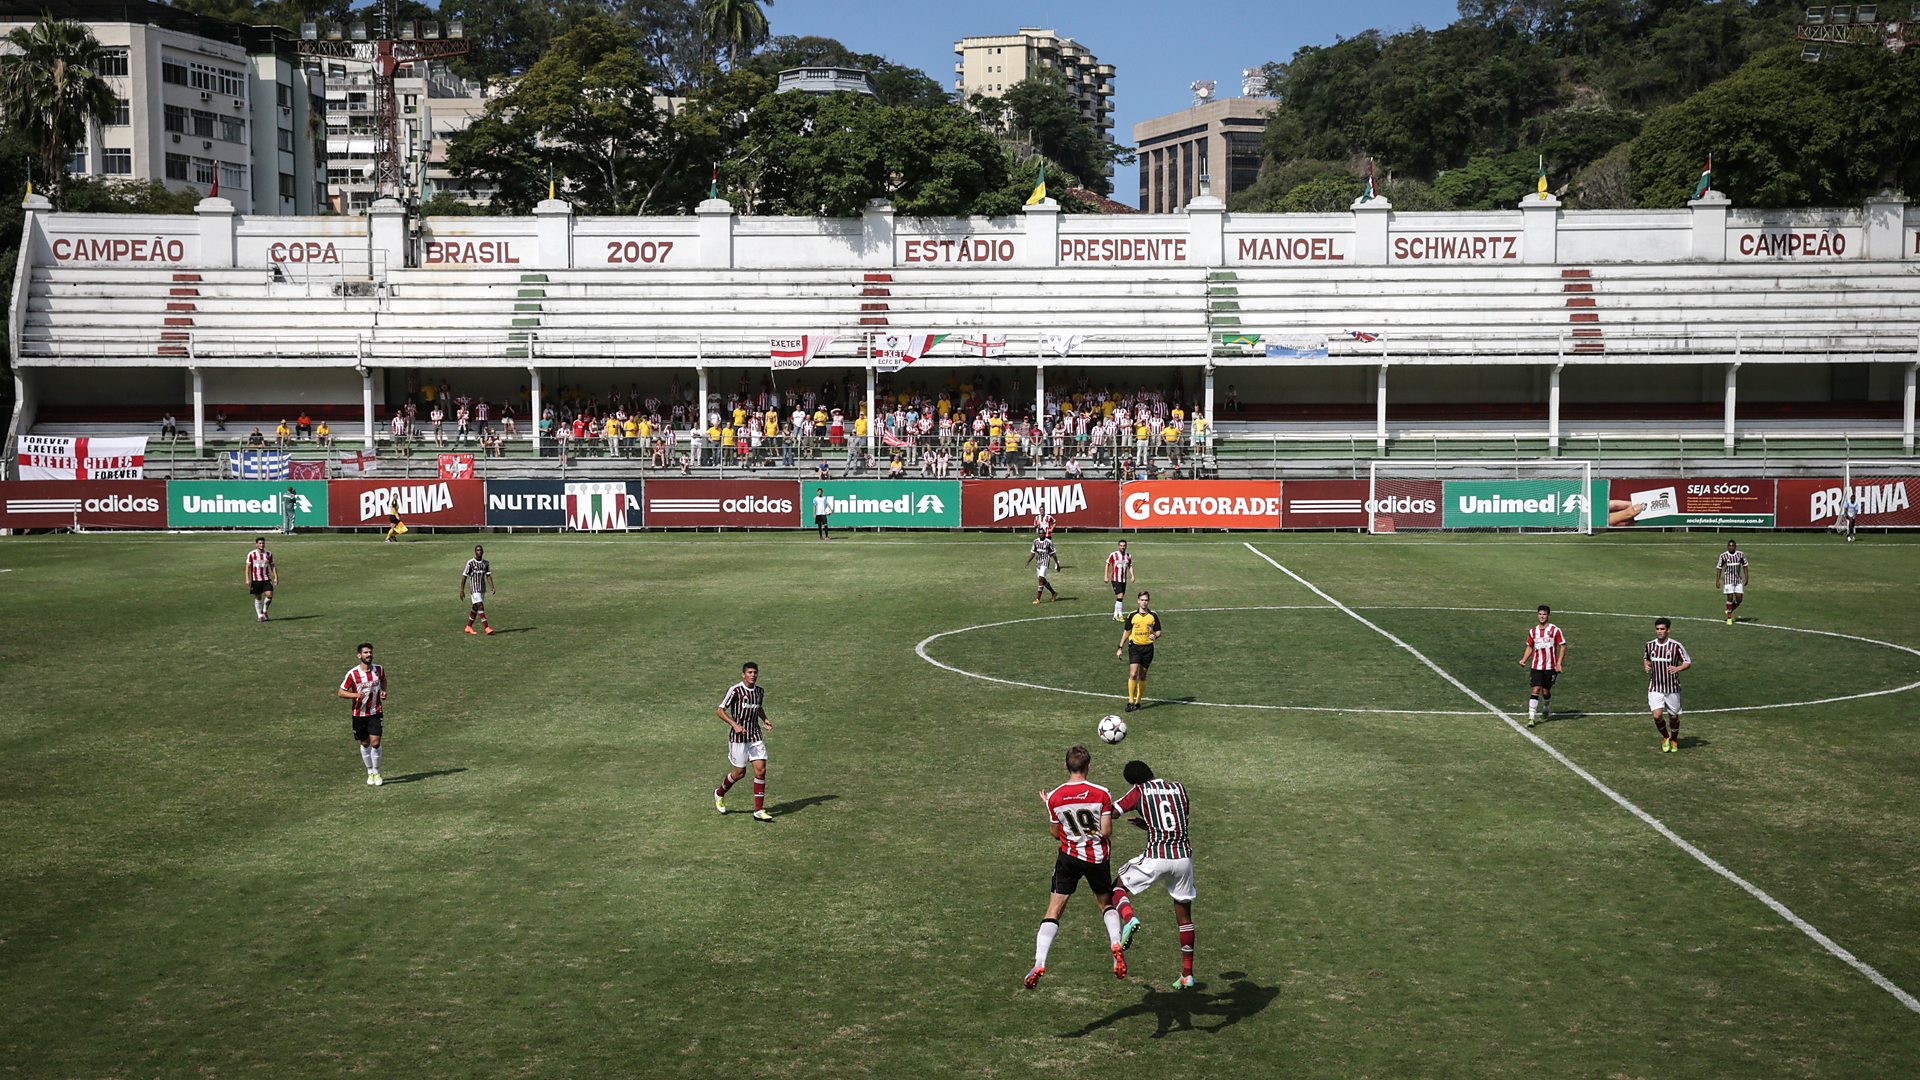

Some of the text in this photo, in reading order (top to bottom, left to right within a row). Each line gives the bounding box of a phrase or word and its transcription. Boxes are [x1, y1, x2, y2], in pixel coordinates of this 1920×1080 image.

[52, 236, 674, 264] CAMPEÃO COPA BRASIL 2007
[905, 236, 1516, 262] ESTÁDIO PRESIDENTE MANOEL SCHWARTZ
[1740, 230, 1846, 256] CAMPEÃO
[774, 360, 802, 368] LONDON
[23, 436, 70, 445] FOREVER
[27, 445, 65, 454] EXETER
[30, 456, 133, 469] EXETER CITY FC
[94, 469, 138, 480] FOREVER
[1687, 482, 1750, 496] SEJA SÓCIO
[84, 494, 160, 513] adidas
[182, 494, 278, 513] Unimed
[360, 482, 454, 522] BRAHMA
[722, 495, 793, 513] adidas
[993, 483, 1088, 522] BRAHMA
[1153, 496, 1280, 516] GATORADE
[1364, 495, 1436, 514] adidas
[1459, 494, 1556, 514] Unimed
[1810, 481, 1910, 522] BRAHMA
[1143, 787, 1181, 795] Unimed
[1063, 808, 1095, 836] 19
[1159, 801, 1177, 831] 6
